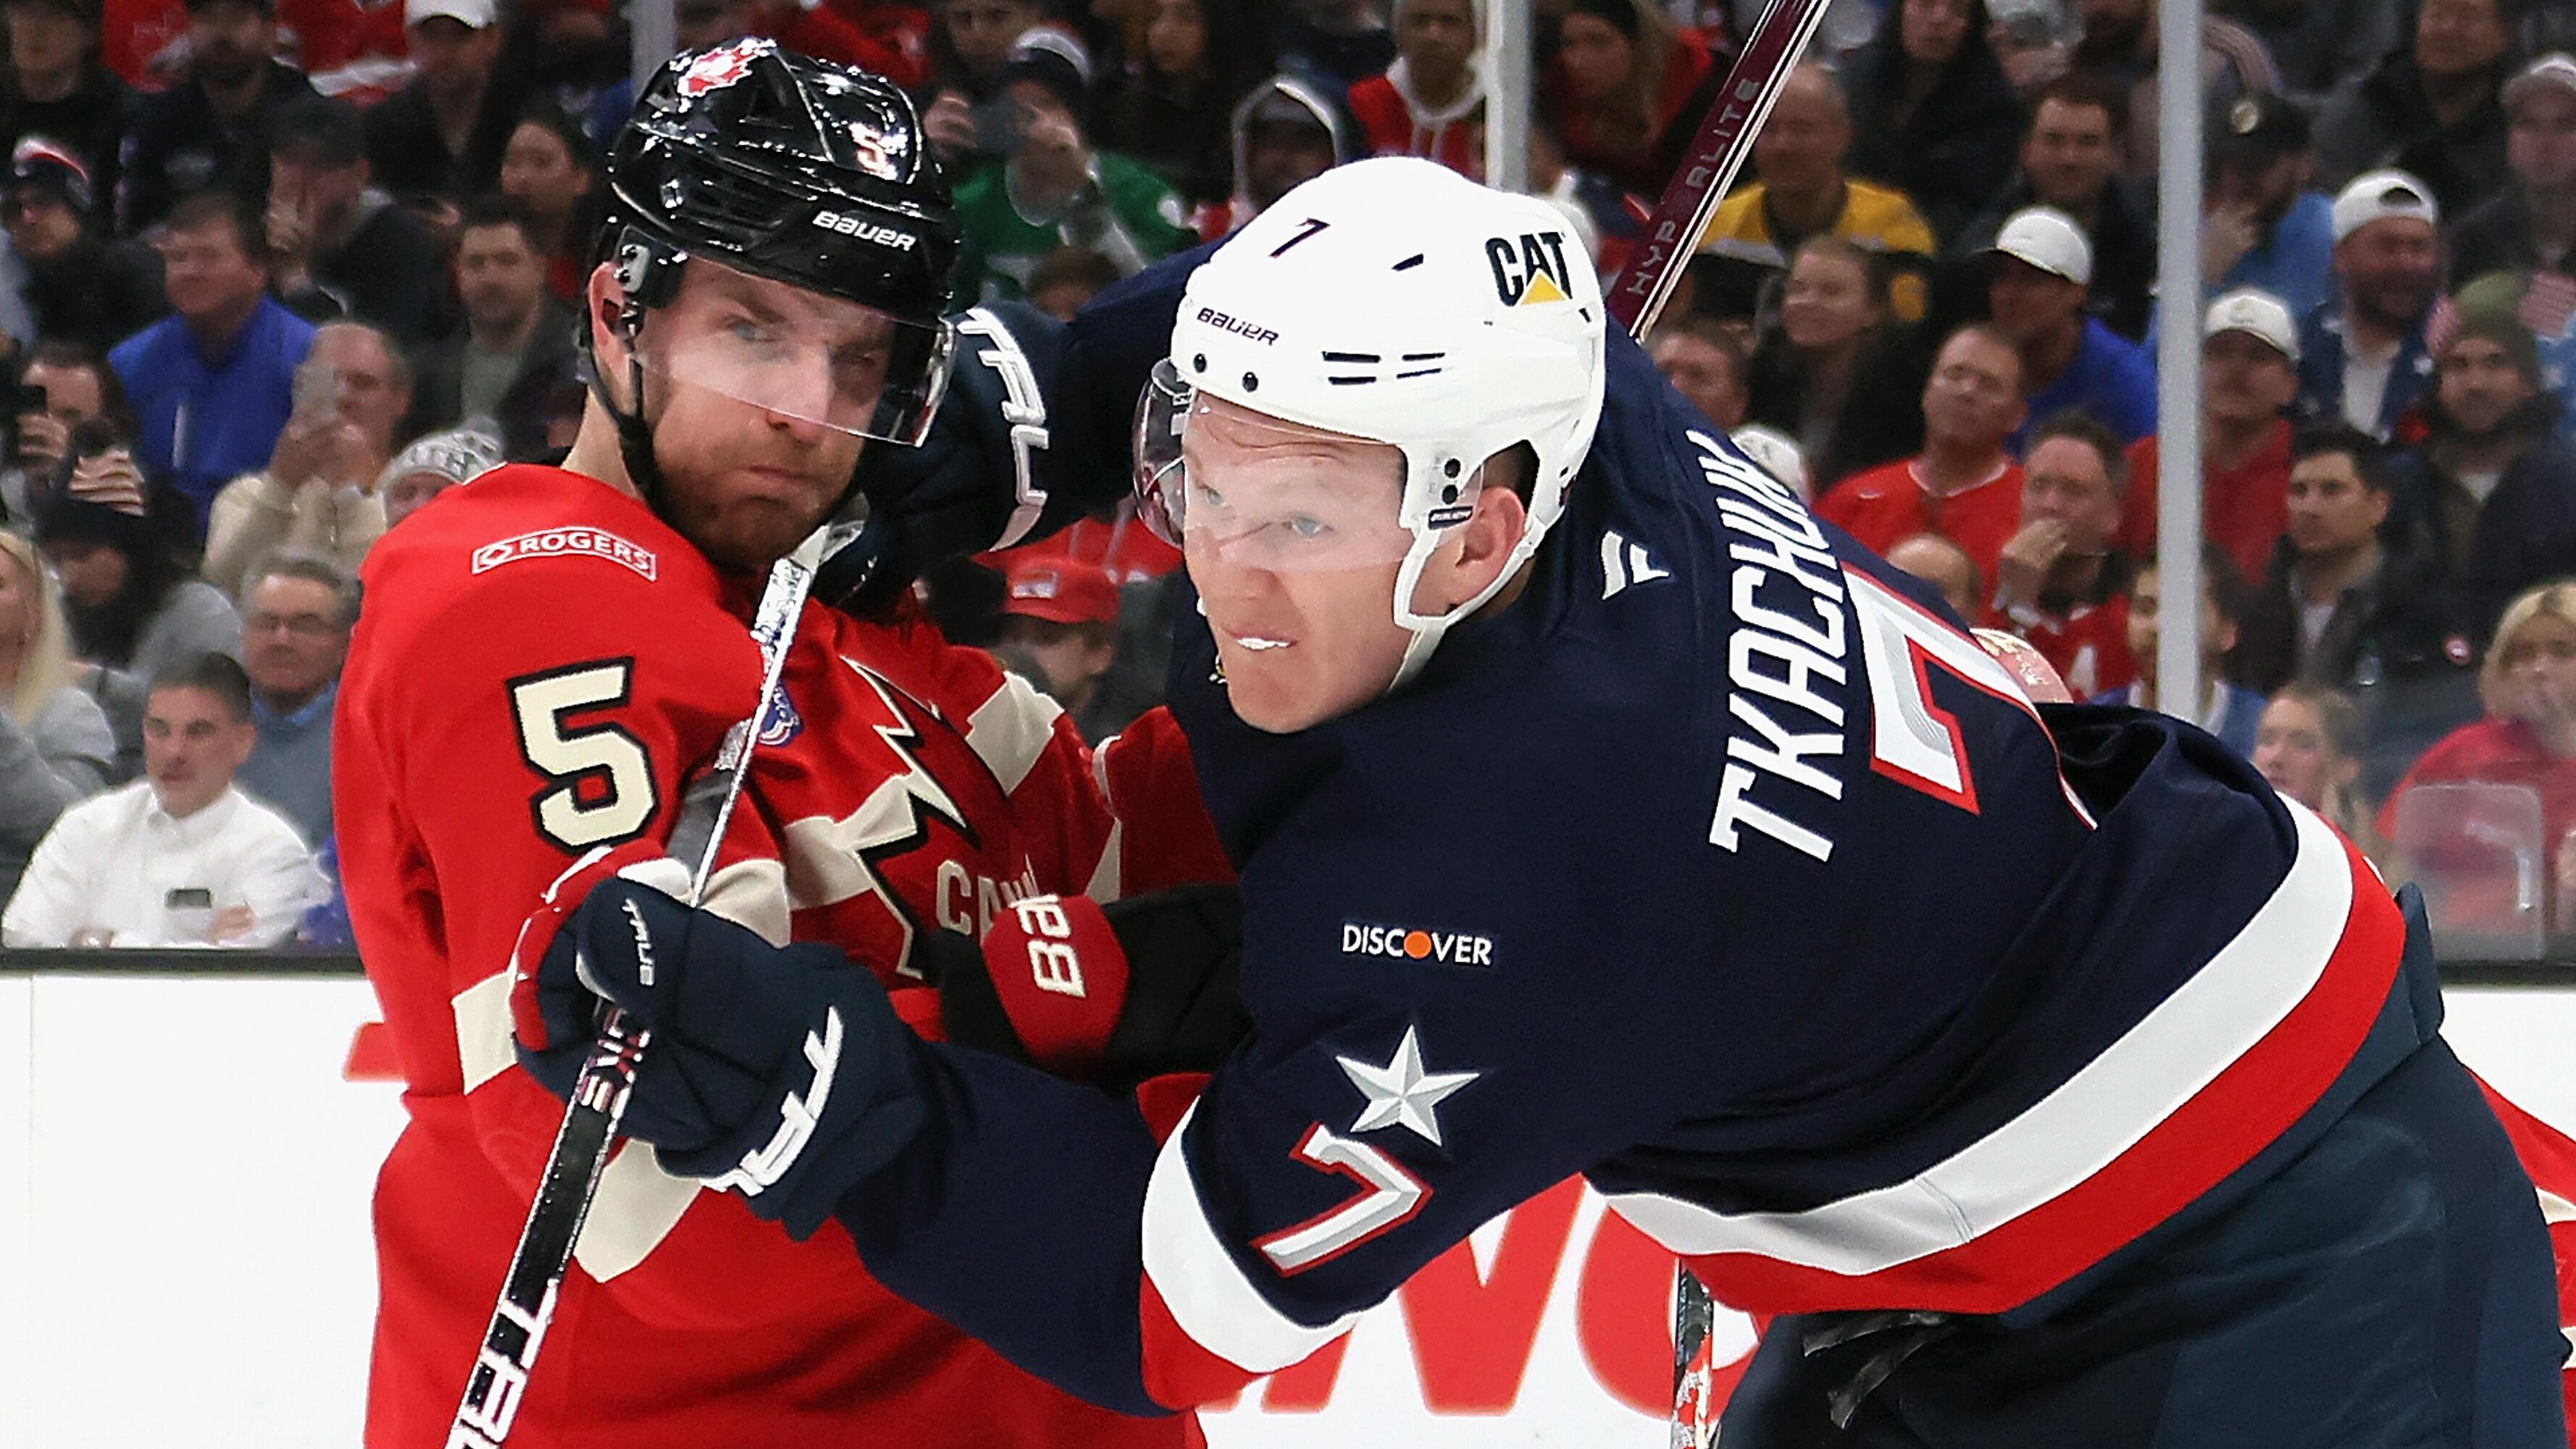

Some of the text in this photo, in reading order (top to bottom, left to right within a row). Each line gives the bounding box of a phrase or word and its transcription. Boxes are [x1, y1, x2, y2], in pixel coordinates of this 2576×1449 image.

[1268, 217, 1332, 259] 7
[1484, 231, 1573, 307] CAT
[519, 531, 650, 571] ROGERS
[1685, 428, 1848, 863] TKACHUK
[505, 656, 661, 856] 5
[1342, 924, 1493, 966] DISCOVER
[1249, 1120, 1434, 1278] 7
